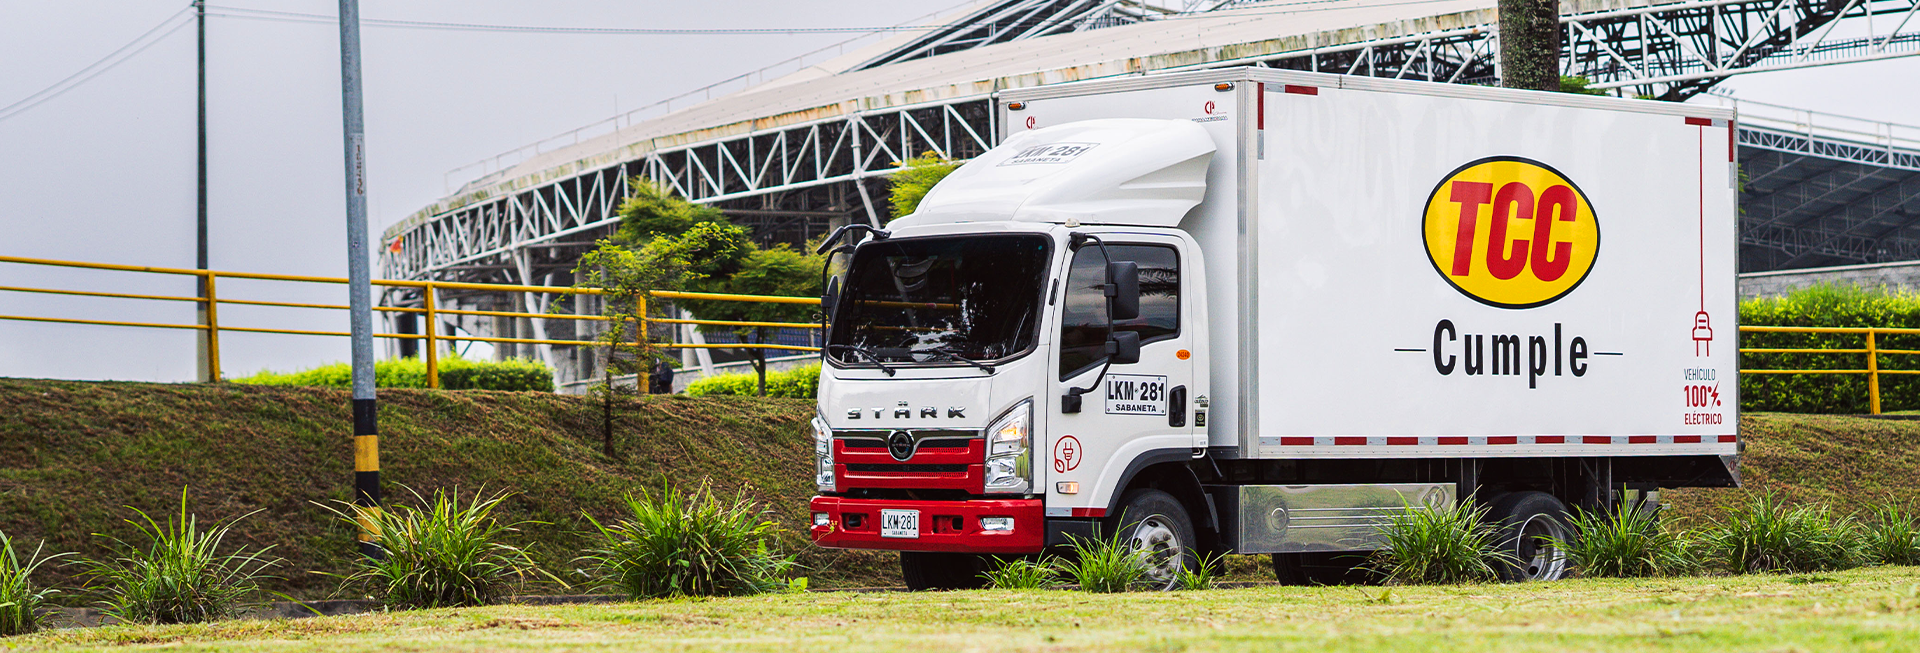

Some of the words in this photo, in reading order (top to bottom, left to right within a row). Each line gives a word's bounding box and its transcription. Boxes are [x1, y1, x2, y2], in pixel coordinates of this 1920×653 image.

[1450, 181, 1578, 282] TCC
[1433, 319, 1588, 389] Cumple
[1684, 366, 1716, 381] VEHÍCULO
[1684, 380, 1722, 410] 100%
[847, 400, 966, 419] STÄRK
[1115, 403, 1157, 412] SABANETA
[1684, 410, 1723, 425] ELÉCTRICO
